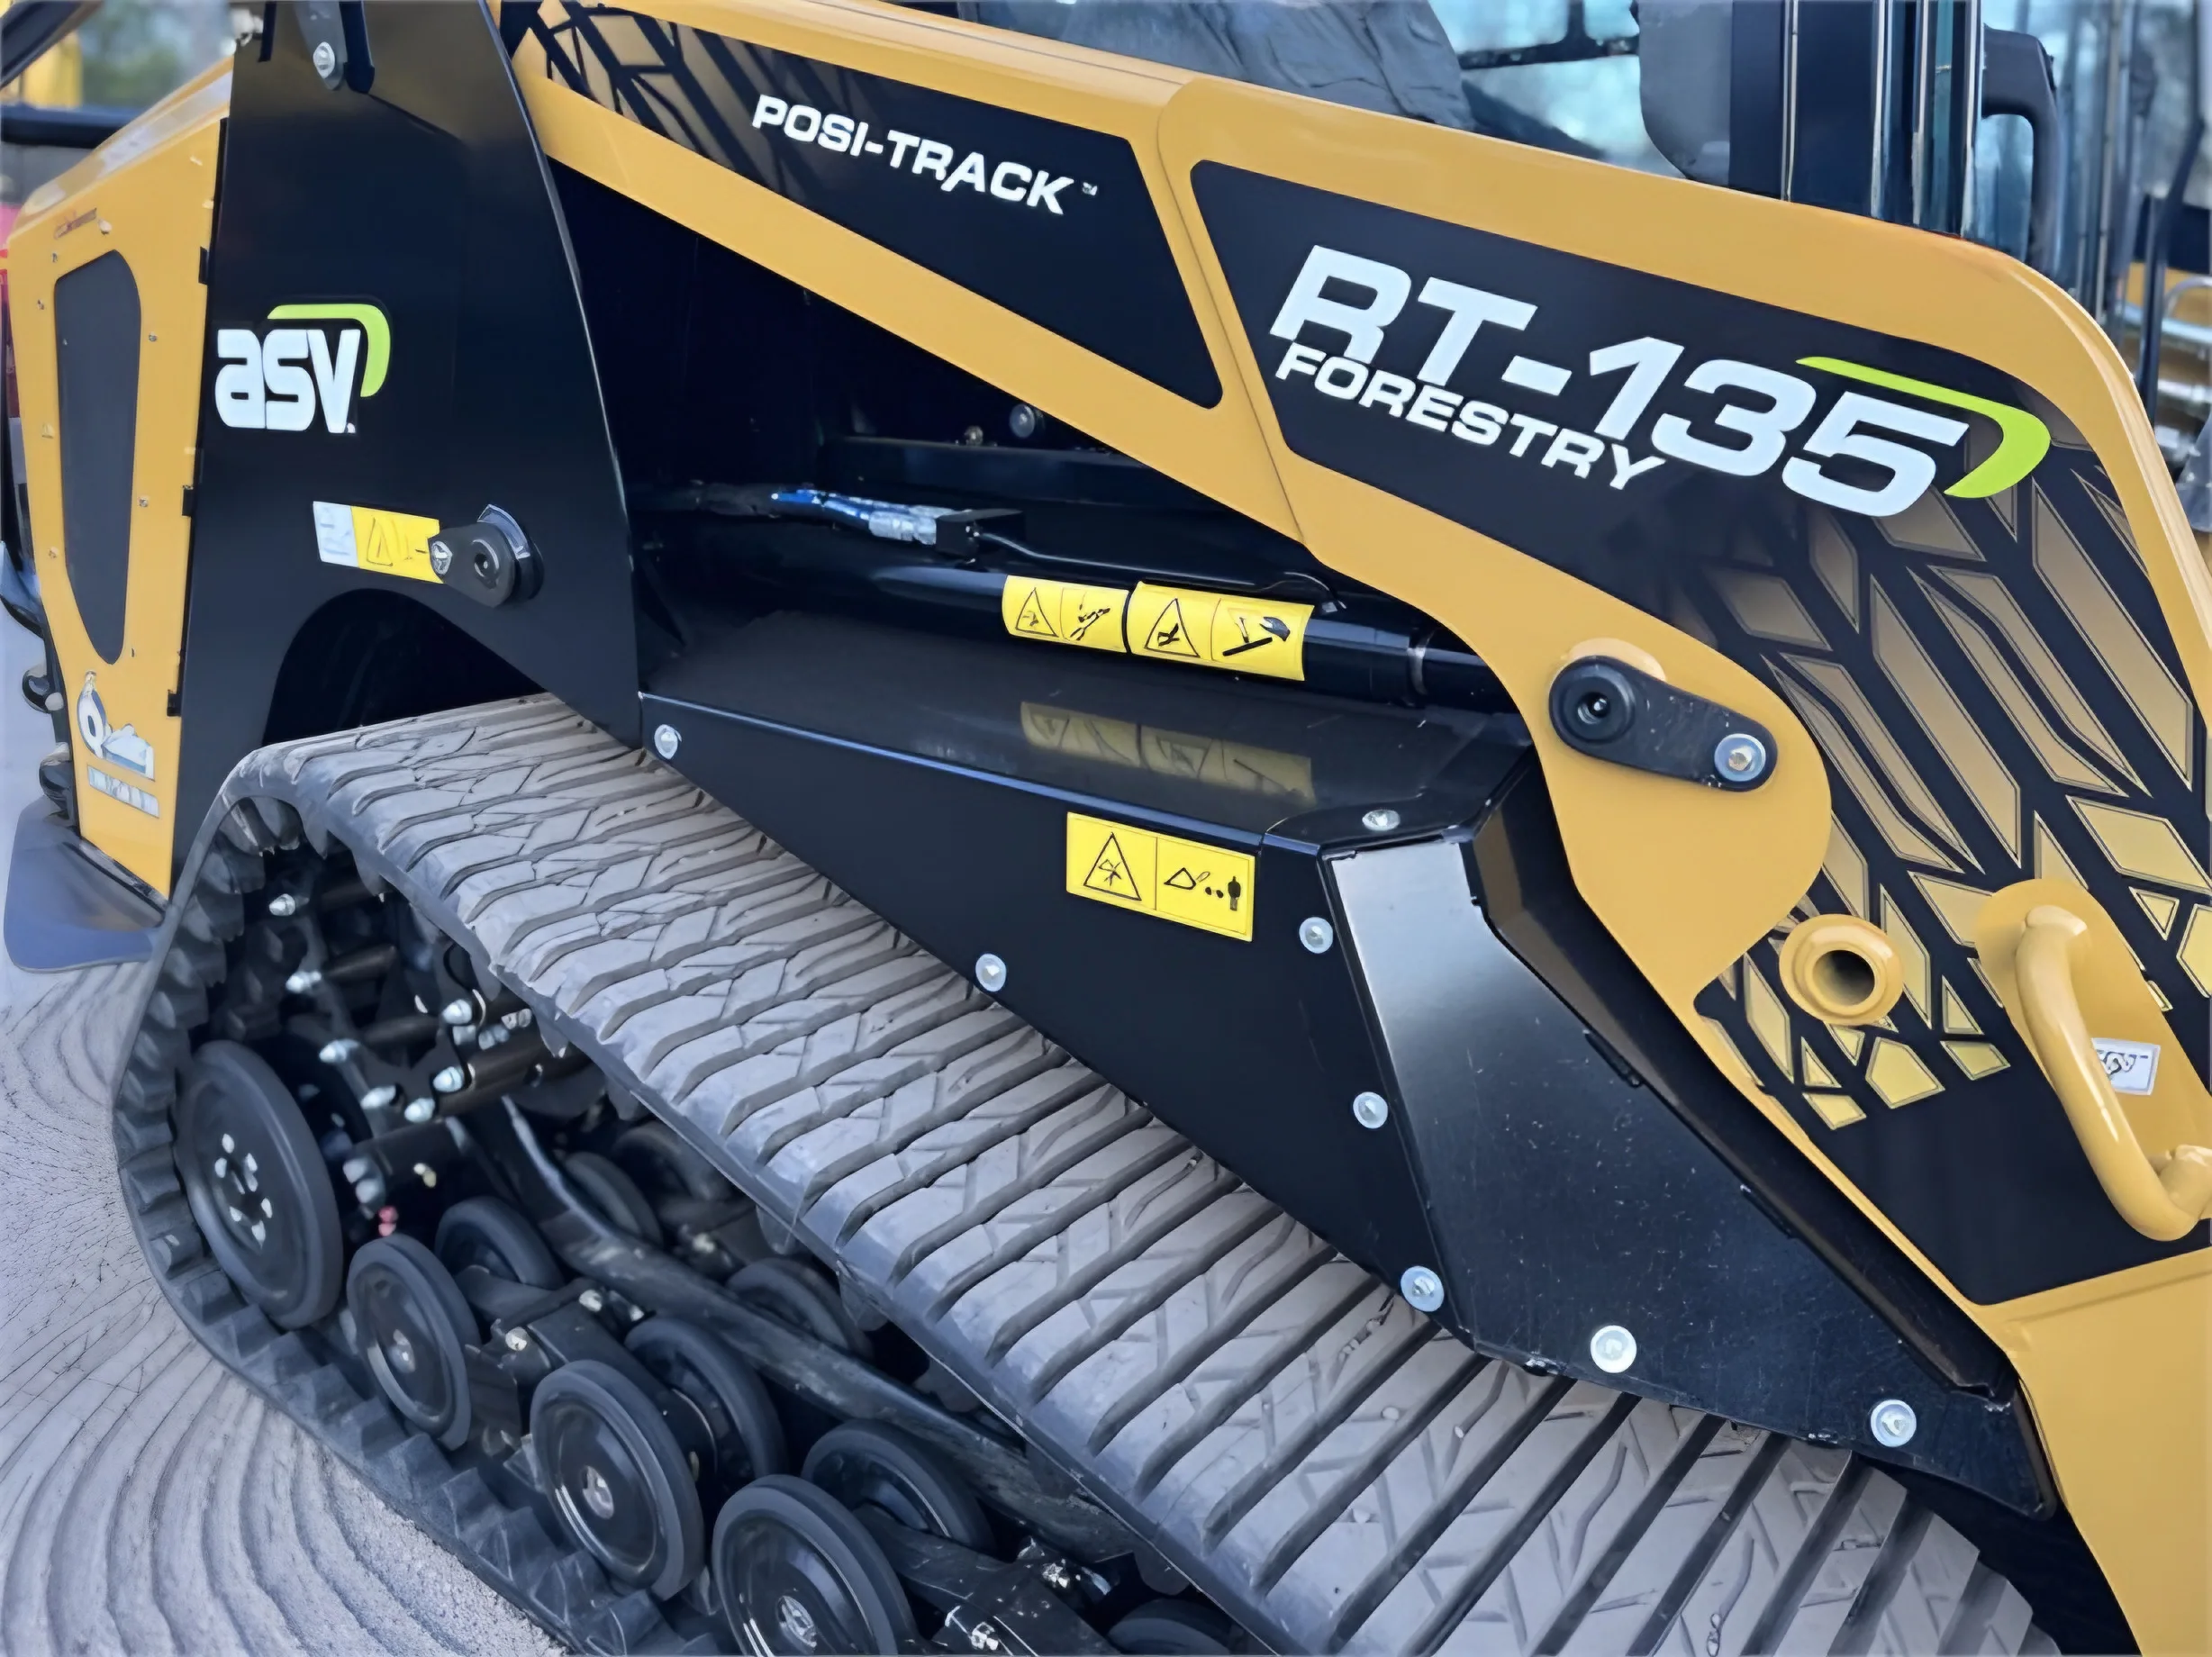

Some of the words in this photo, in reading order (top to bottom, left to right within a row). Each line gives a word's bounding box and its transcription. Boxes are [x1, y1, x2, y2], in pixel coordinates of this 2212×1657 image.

[752, 95, 1074, 215] POSI-TRACK
[1269, 244, 1970, 518] RT-135
[1275, 343, 1666, 491] FORESTRY
